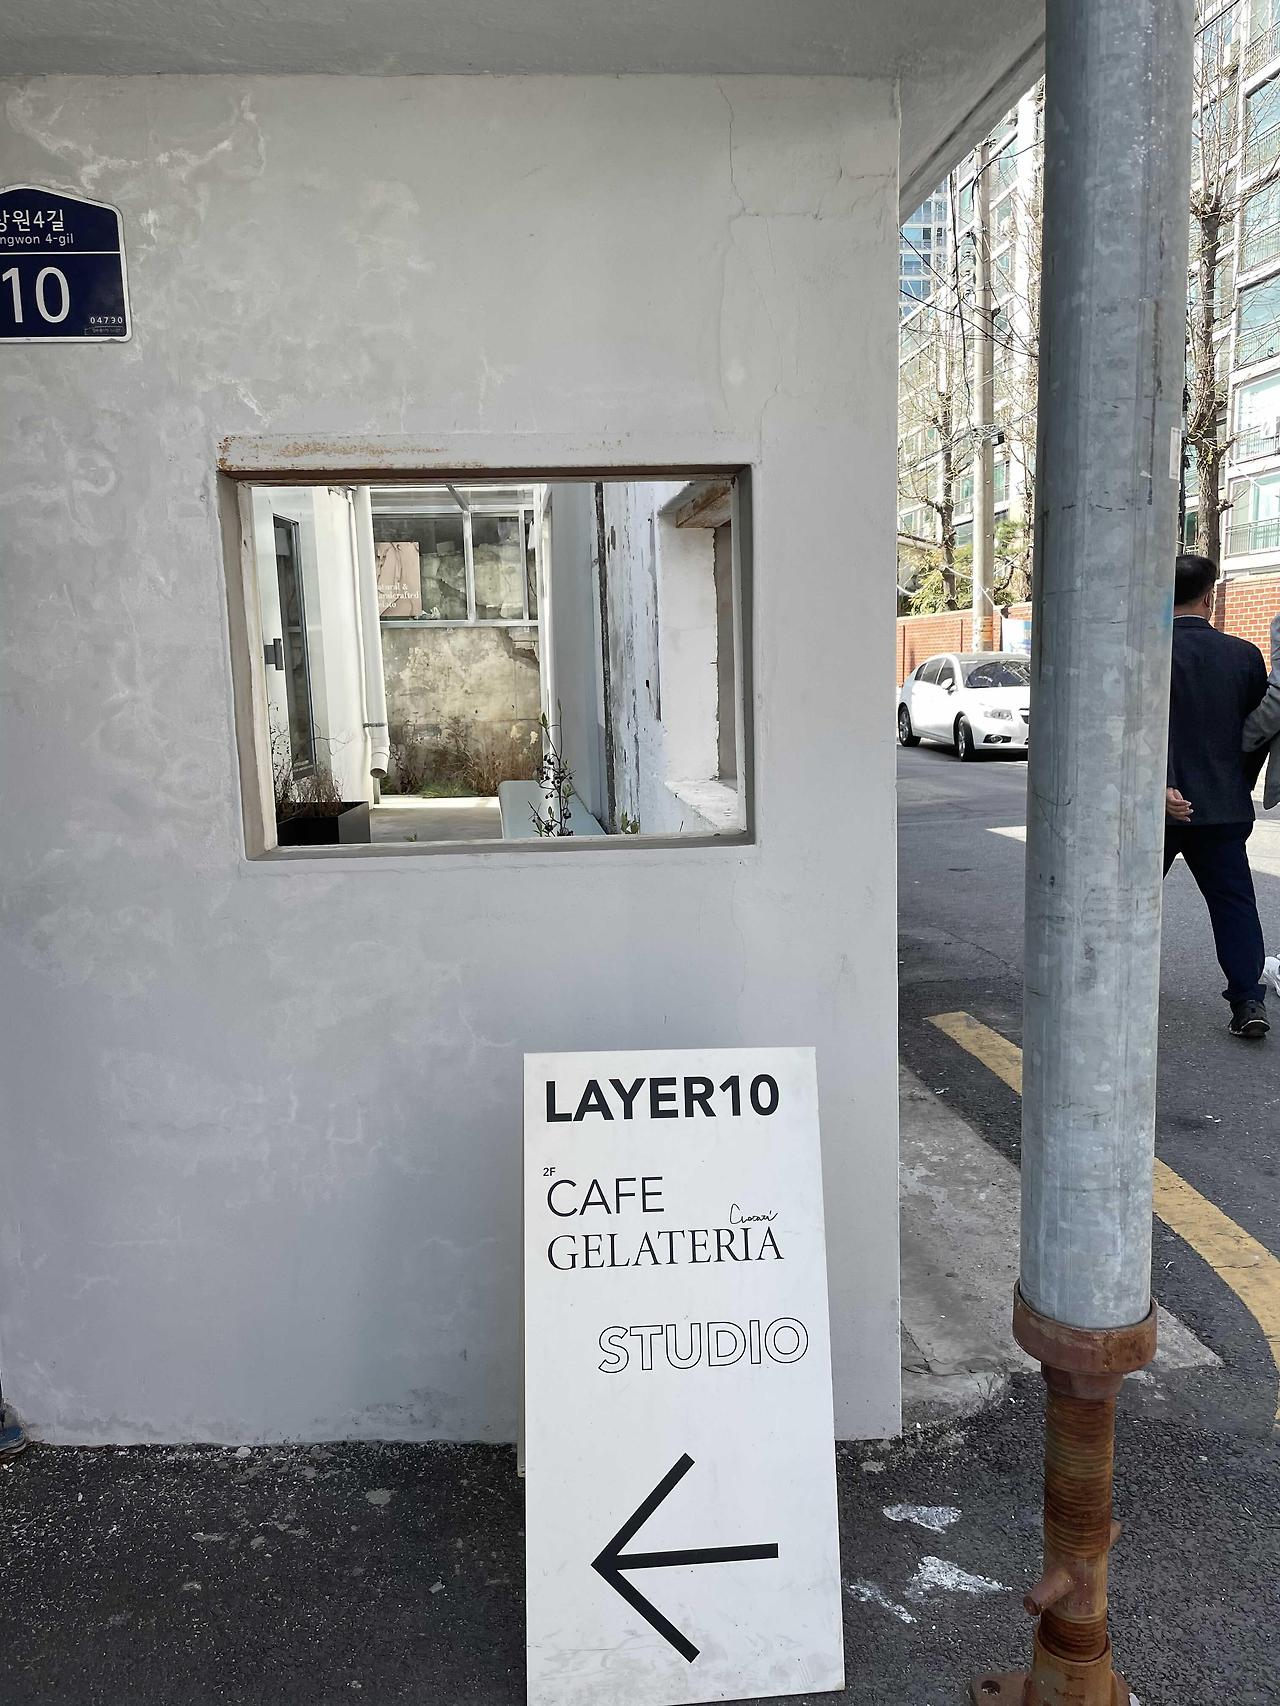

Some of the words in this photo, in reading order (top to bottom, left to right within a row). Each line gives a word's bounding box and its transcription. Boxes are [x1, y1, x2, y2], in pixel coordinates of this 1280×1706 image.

[45, 233, 73, 247] 4-gil
[1, 266, 70, 323] 10
[90, 316, 123, 324] 04730
[378, 582, 399, 591] atural
[379, 591, 419, 599] andcrafted
[546, 1074, 780, 1122] LAYER10
[543, 1167, 556, 1176] 2F
[547, 1176, 665, 1217] CAFE
[547, 1226, 785, 1271] GELATERIA
[598, 1317, 809, 1374] STUDIO
